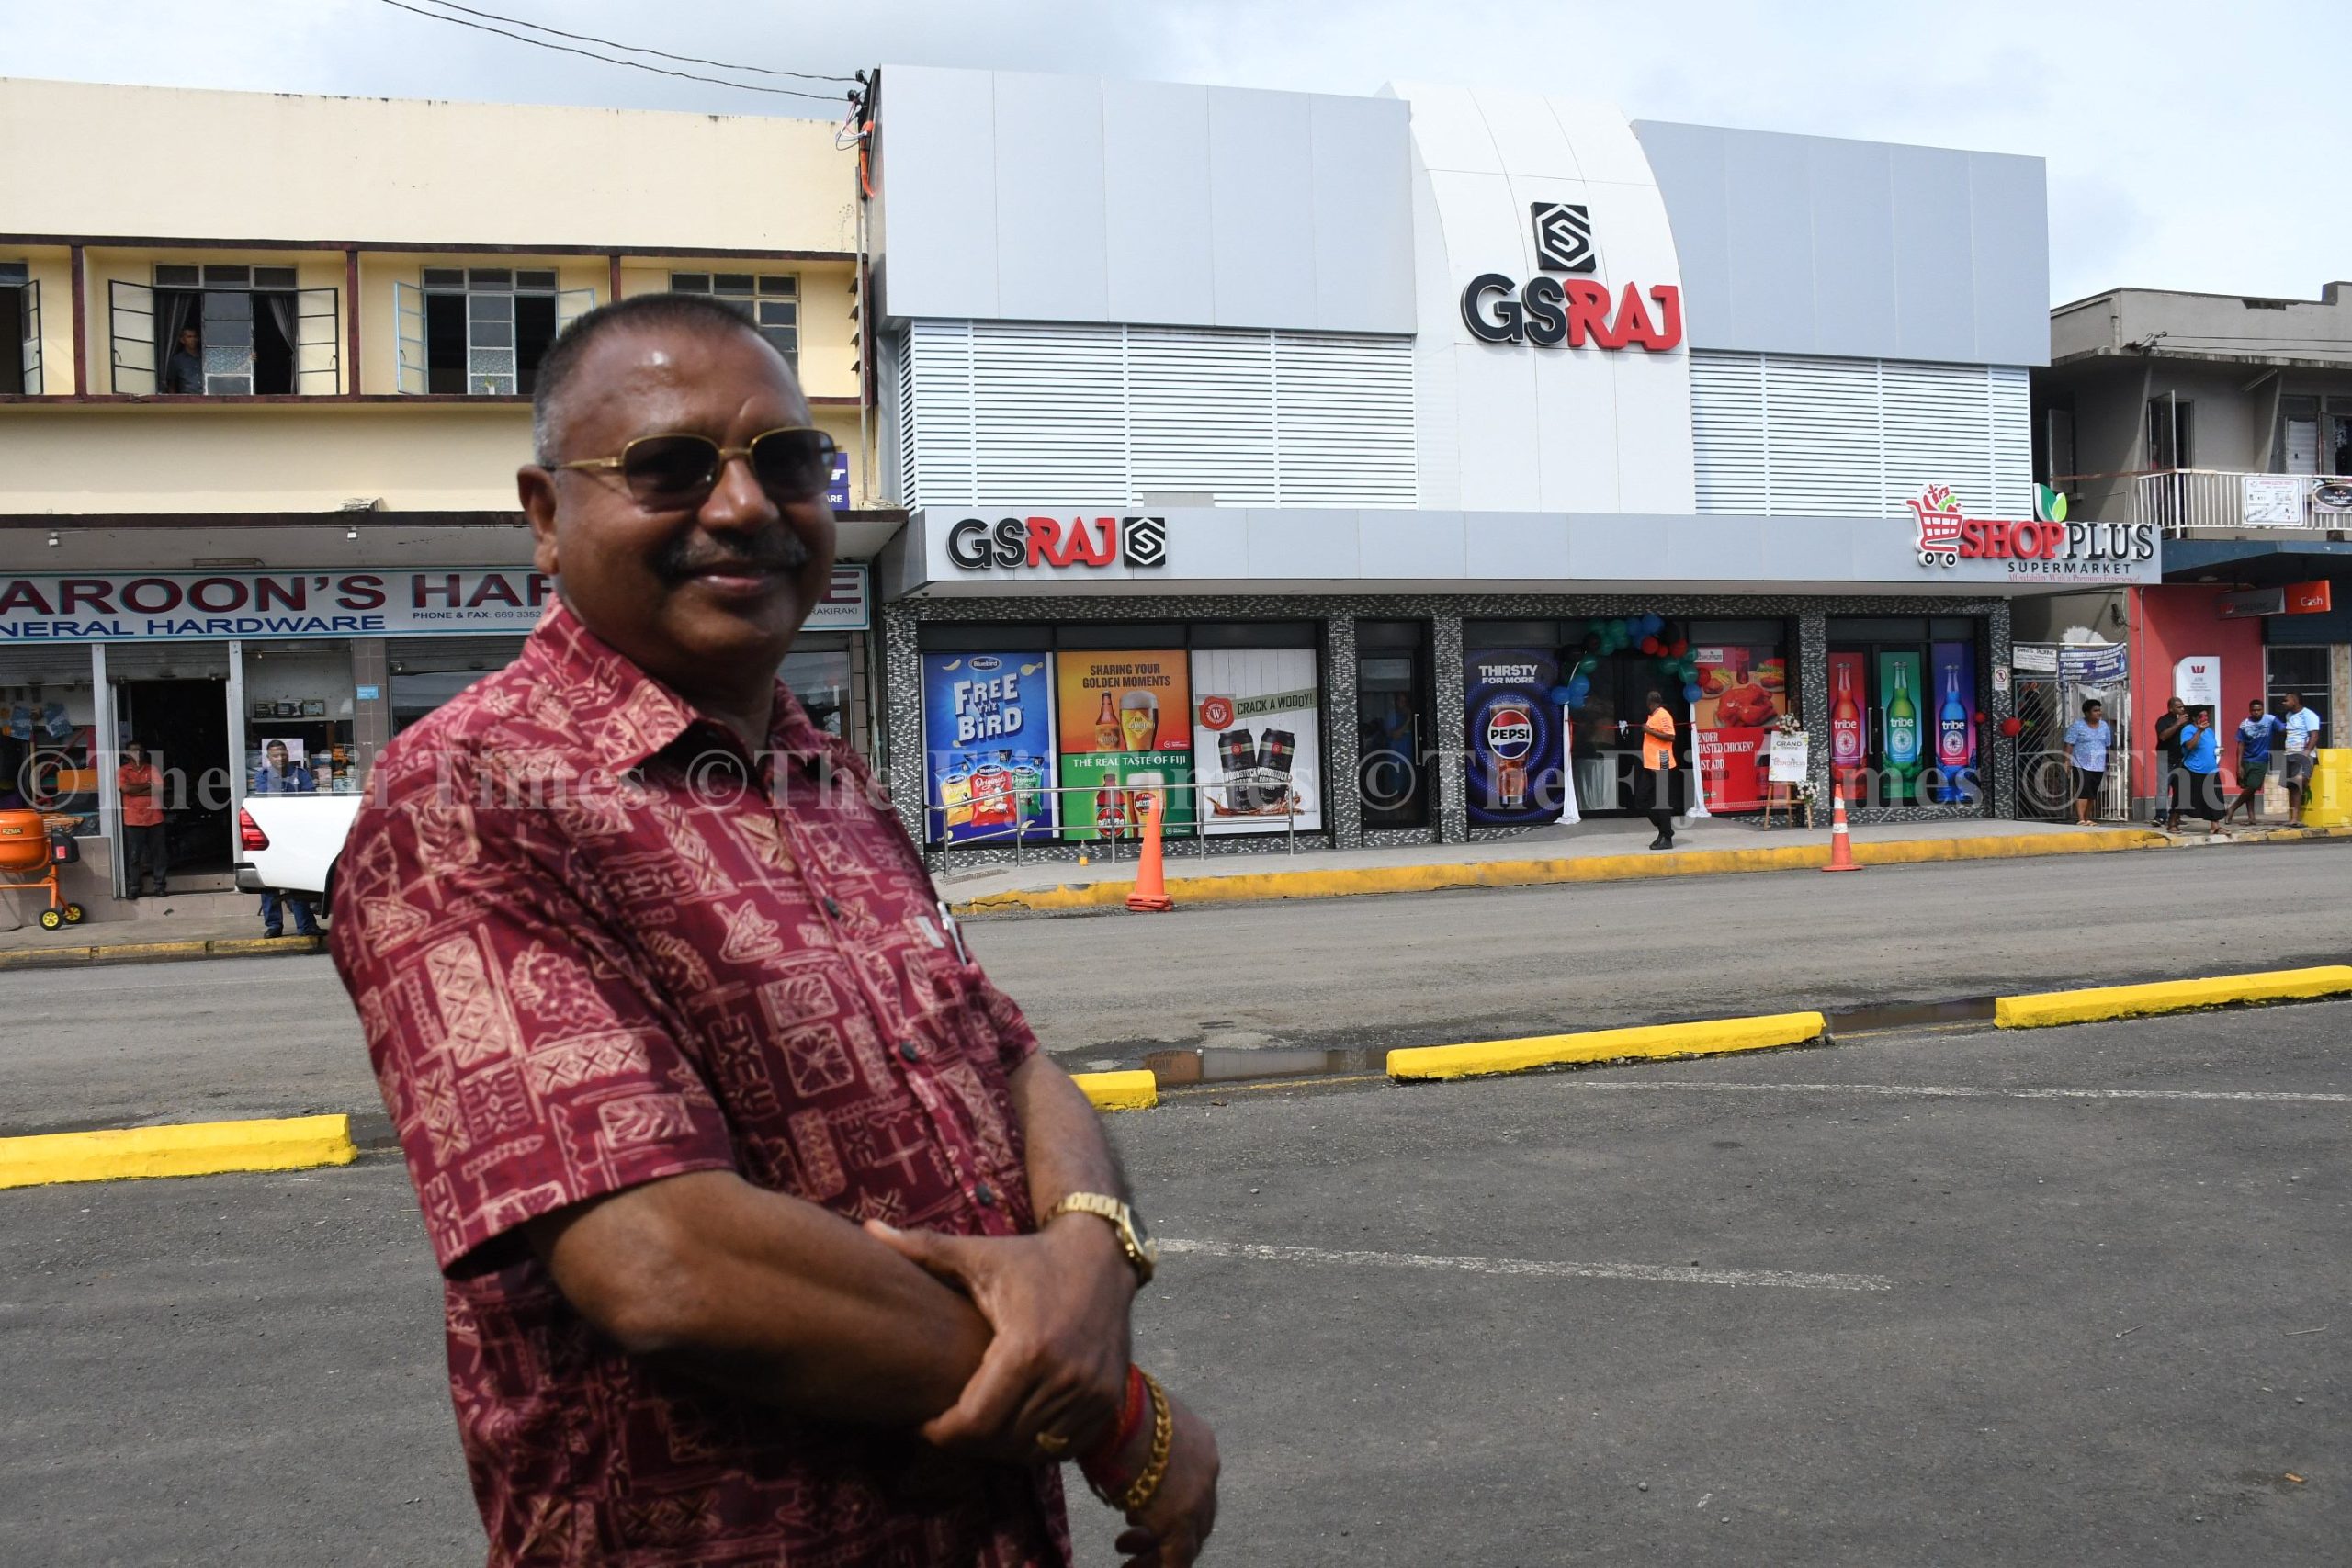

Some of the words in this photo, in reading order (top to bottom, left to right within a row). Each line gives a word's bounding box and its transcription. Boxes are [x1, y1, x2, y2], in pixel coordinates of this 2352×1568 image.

[2007, 561, 2132, 574] SUPERMARKET
[2007, 573, 2046, 582] Affordability
[2301, 596, 2323, 607] Cash
[147, 615, 386, 635] HARDWARE
[1090, 664, 1133, 676] SHARING
[1135, 663, 1160, 674] YOUR
[1478, 664, 1538, 677] THIRSTY
[1082, 677, 1121, 689] GOLDEN
[1122, 675, 1171, 688] MOMENTS
[1505, 676, 1535, 684] MORE
[954, 673, 1018, 716] FREE
[978, 702, 999, 713] THE
[1237, 699, 1268, 715] CRACK
[1270, 699, 1275, 710] A
[1277, 693, 1313, 708] WOODY!
[1834, 719, 1857, 729] tribe
[1890, 717, 1914, 728] tribe
[1941, 720, 1965, 730] tribe
[1490, 728, 1530, 739] PEPSI
[1697, 732, 1718, 743] ENDER
[1698, 742, 1723, 754] OASTED
[1723, 741, 1754, 753] CHICKEN?
[1073, 758, 1093, 768] THE
[1095, 758, 1120, 767] REAL
[1123, 756, 1152, 767] TASTE
[1153, 755, 1168, 765] OF
[1170, 755, 1186, 765] FIJI
[1711, 759, 1724, 770] ADD
[1225, 768, 1257, 782] WOODSTOCK
[1257, 766, 1287, 781] WOODSTOCK
